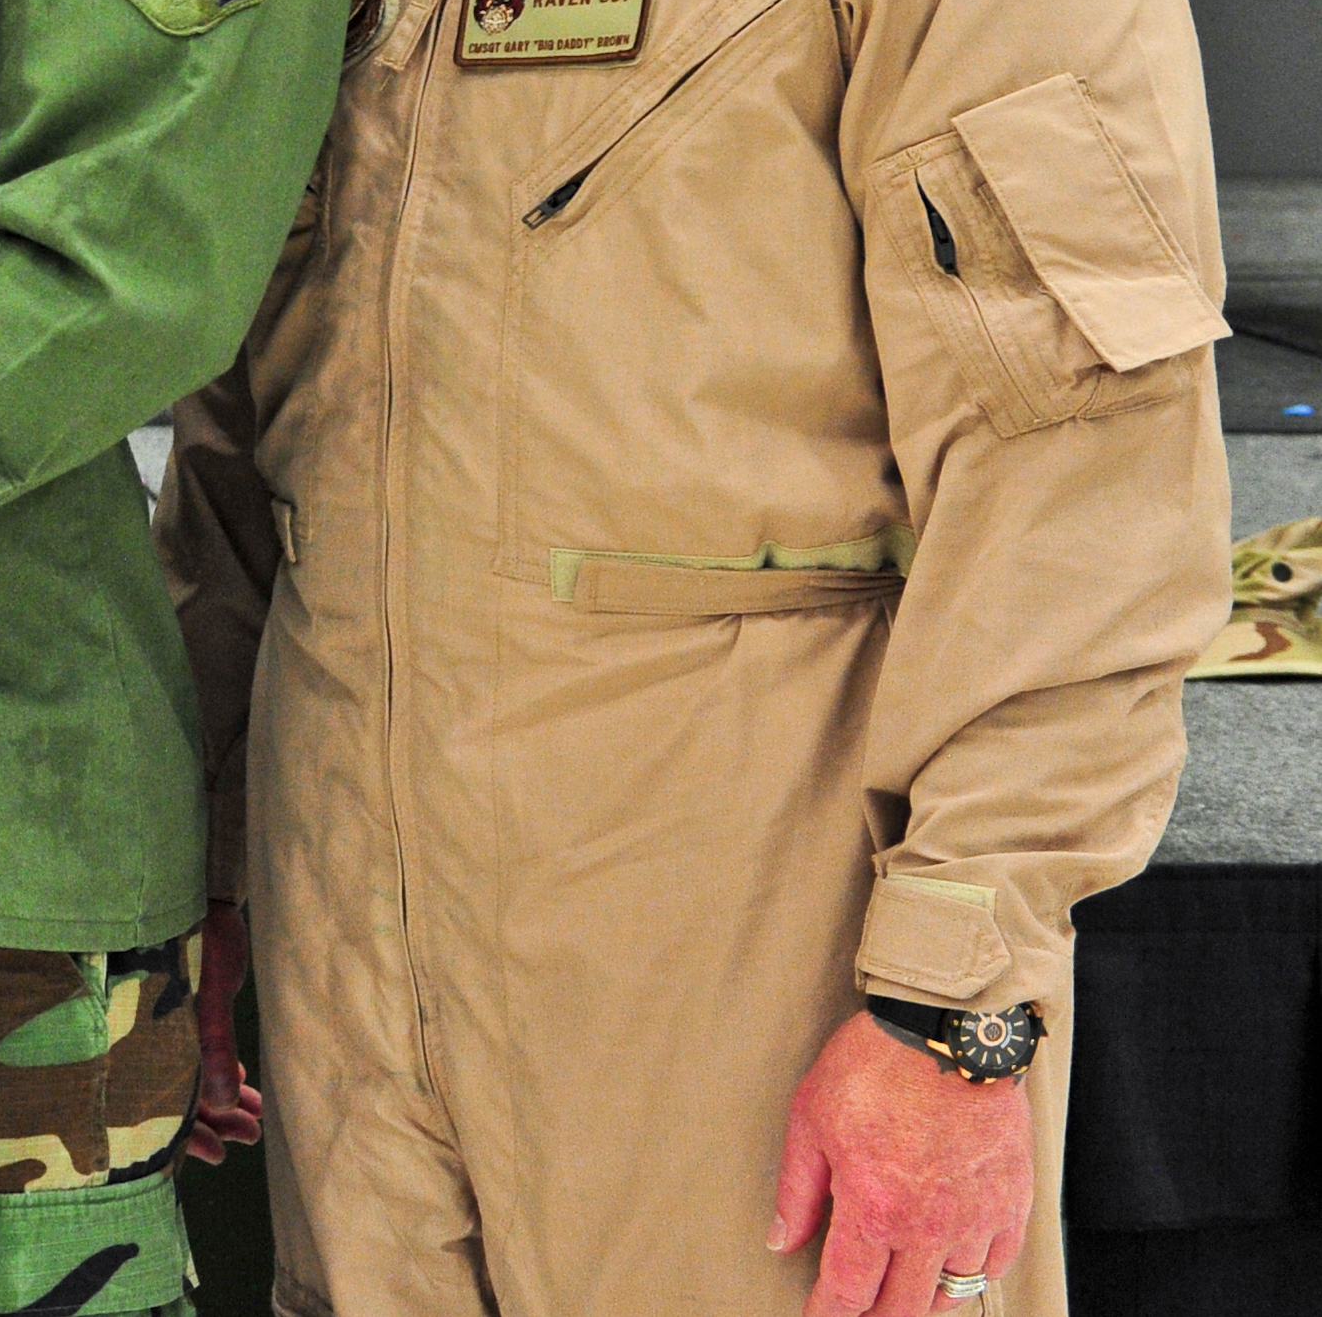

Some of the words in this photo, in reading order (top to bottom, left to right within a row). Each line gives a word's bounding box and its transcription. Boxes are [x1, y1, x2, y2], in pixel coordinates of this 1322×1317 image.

[469, 41, 501, 53] CMSGT
[504, 40, 530, 53] GARY
[597, 35, 630, 47] BROWN
